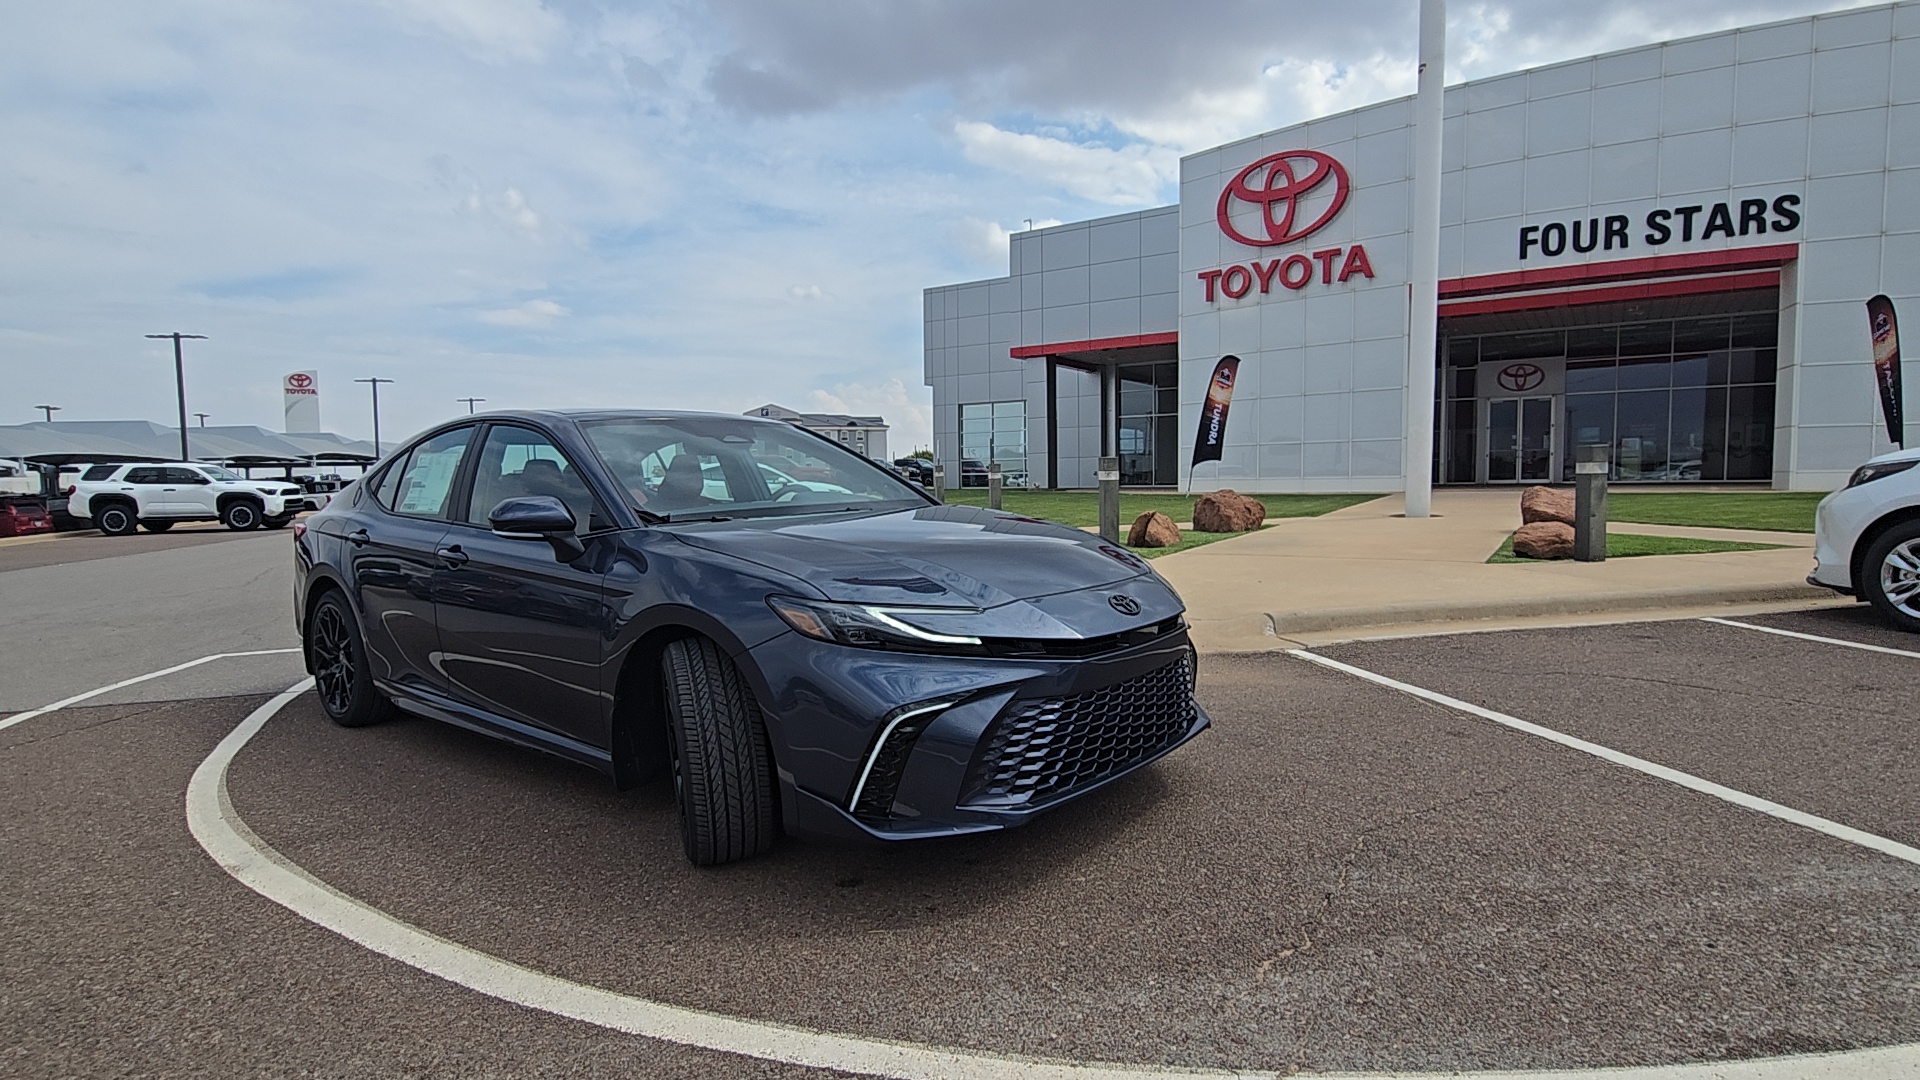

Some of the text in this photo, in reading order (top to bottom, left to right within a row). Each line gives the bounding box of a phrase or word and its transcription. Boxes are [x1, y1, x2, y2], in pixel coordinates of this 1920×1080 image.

[1519, 194, 1801, 260] FOUR STARS
[1198, 244, 1375, 303] TOYOTA
[1207, 403, 1222, 445] TUNDRA
